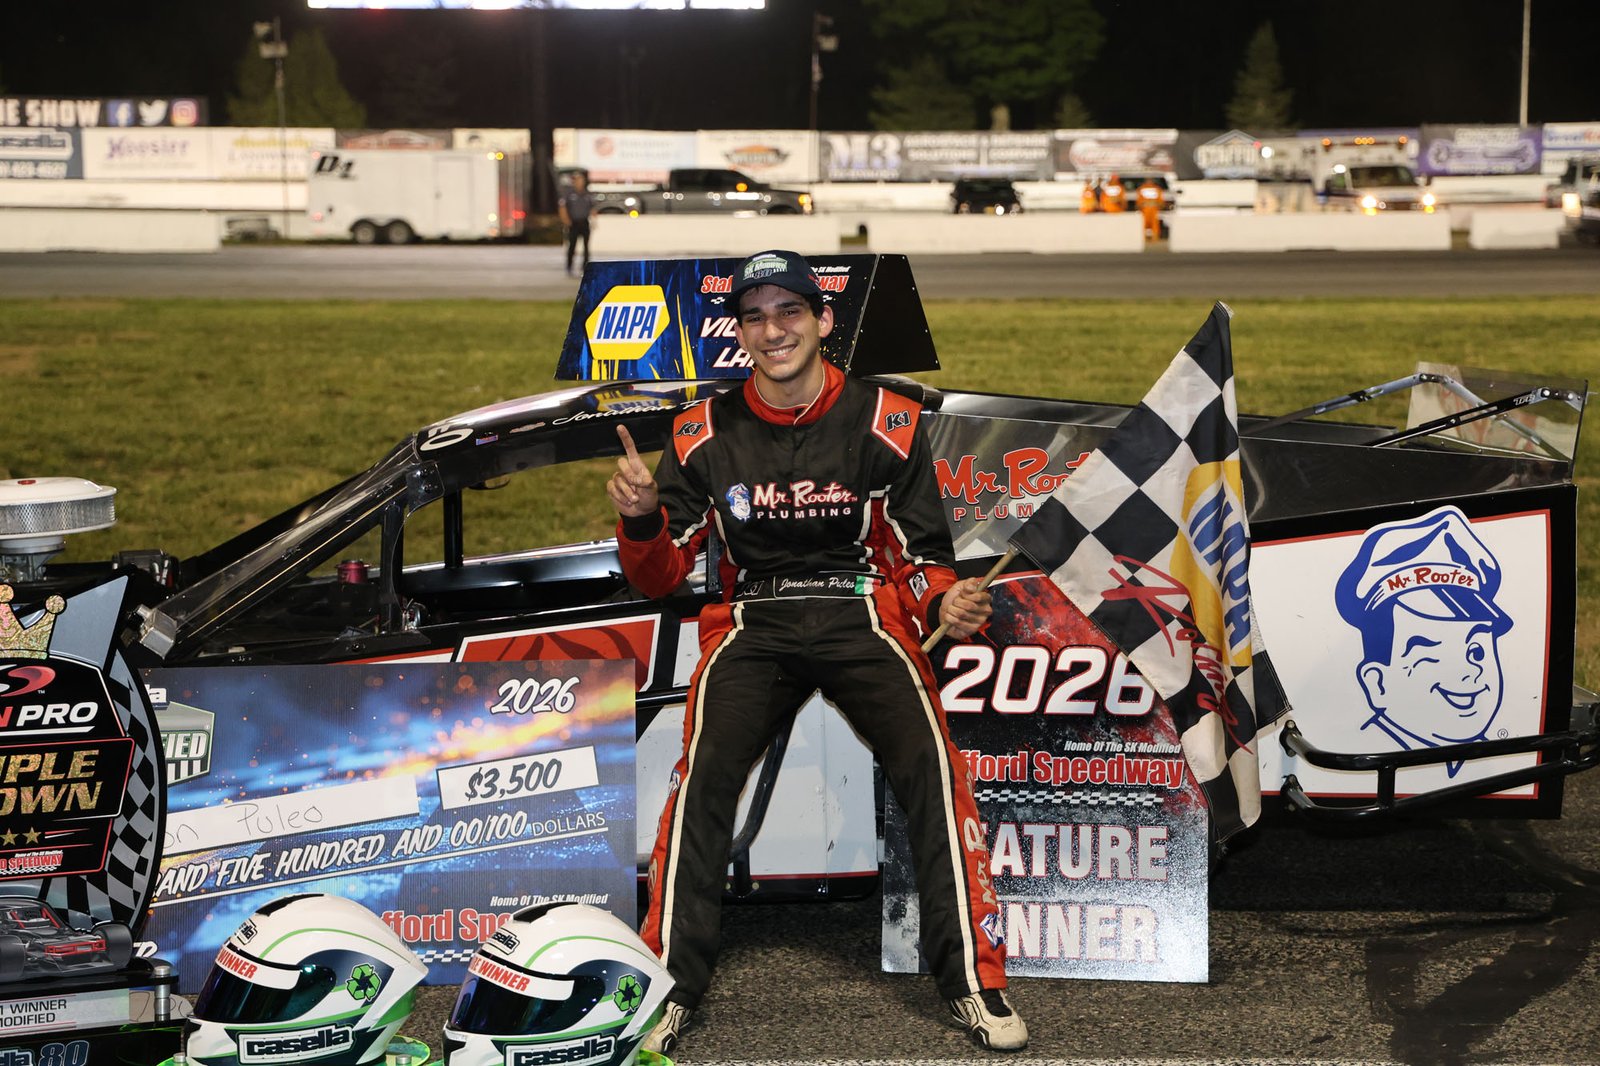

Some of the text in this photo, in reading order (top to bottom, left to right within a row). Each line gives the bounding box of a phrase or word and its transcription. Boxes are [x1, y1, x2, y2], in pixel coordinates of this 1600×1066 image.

[25, 99, 100, 127] SHOW
[597, 305, 657, 339] NAPA
[700, 317, 737, 337] VIC
[675, 420, 705, 437] K1
[886, 411, 911, 432] K1
[933, 454, 1008, 504] Mr.
[753, 482, 791, 509] Mr.
[790, 479, 852, 508] Rooter
[756, 507, 852, 519] PLUMBING
[953, 502, 1034, 522] PLUM
[779, 577, 825, 592] Jonathan
[1387, 567, 1474, 591] Mr. Rooter
[940, 644, 1155, 716] 2026
[491, 677, 580, 714] 2026
[16, 702, 98, 727] PRO
[1064, 741, 1181, 753] Home Of The SK Modified
[465, 758, 562, 801] $3,500
[1033, 751, 1184, 789] Speedway
[0, 781, 103, 816] OWN
[225, 803, 323, 835] Puleo
[9, 854, 63, 870] SPEEDWAY
[154, 810, 606, 897] AND FIVE HUNDRED AND 00/100 DOLLARS
[990, 822, 1168, 881] ATURE
[490, 895, 518, 907] Home
[520, 895, 532, 906] Of
[532, 894, 550, 904] The
[567, 894, 608, 904] Modified
[1006, 902, 1159, 962] NNER
[217, 948, 258, 979] WINNER
[479, 958, 530, 991] WINNER
[10, 999, 67, 1014] WINNER
[38, 1041, 89, 1066] 80
[246, 1028, 350, 1056] casella
[514, 1038, 612, 1066] casella
